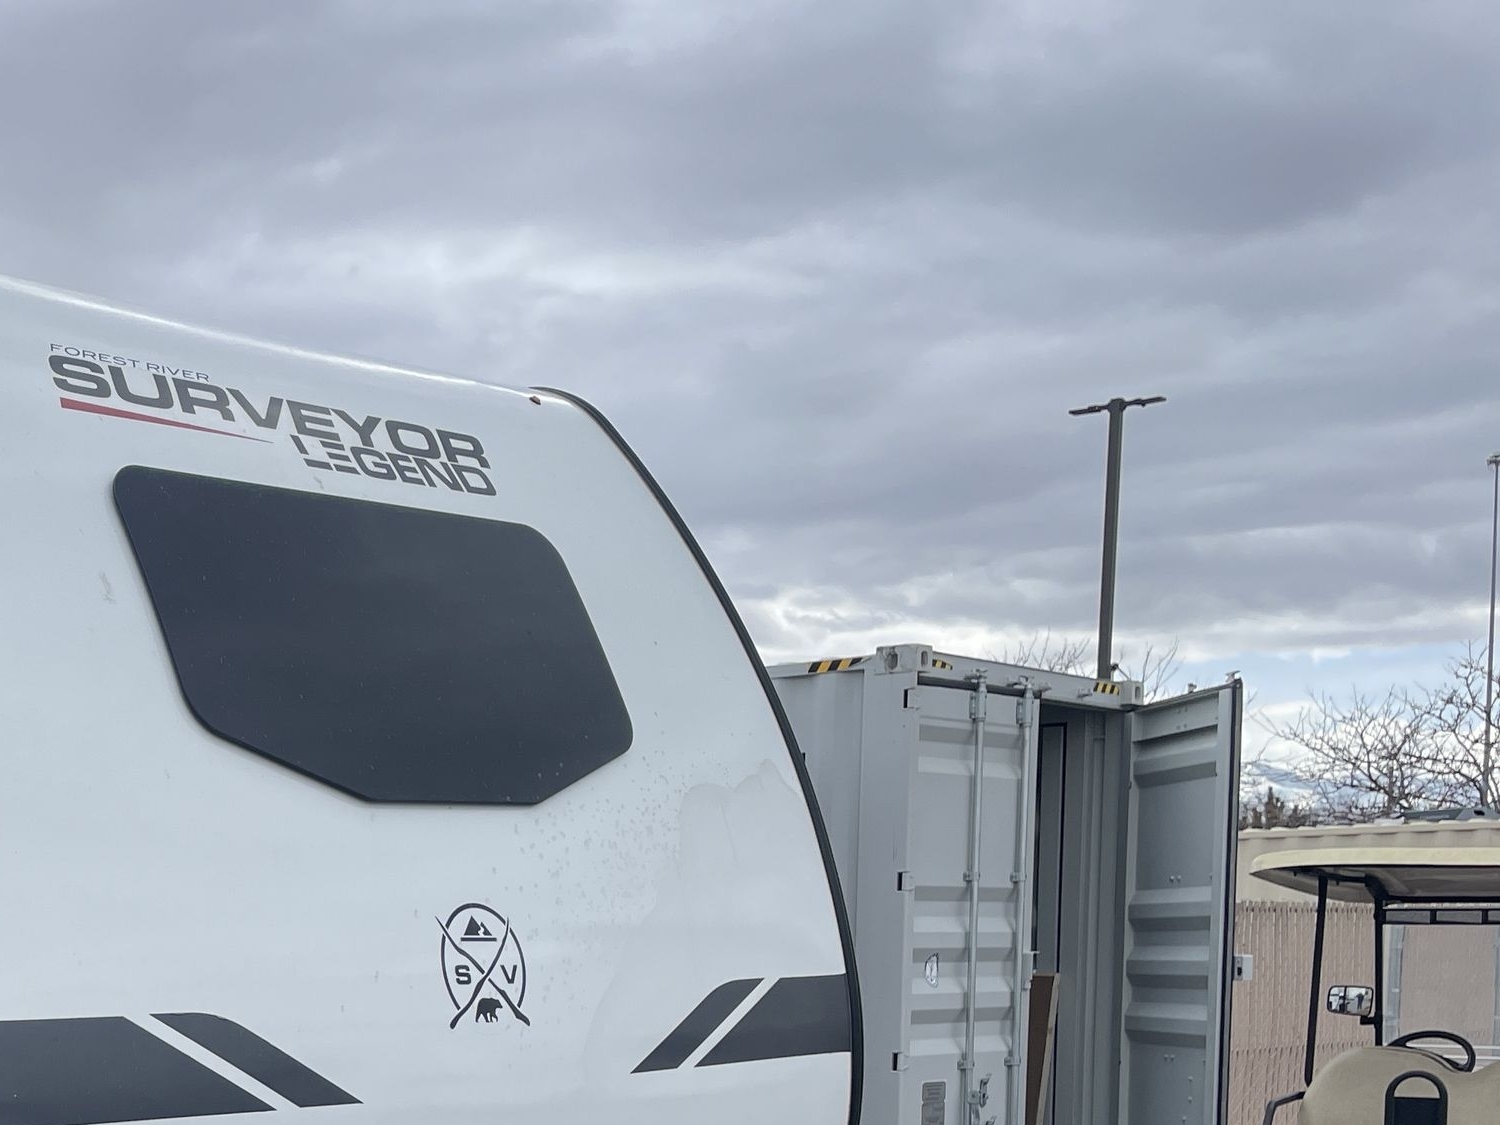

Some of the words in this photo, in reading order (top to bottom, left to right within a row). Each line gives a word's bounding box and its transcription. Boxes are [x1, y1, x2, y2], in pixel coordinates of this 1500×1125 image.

[49, 343, 140, 369] FOREST
[146, 361, 210, 383] RIVER
[48, 355, 491, 469] SURVEYOR
[289, 434, 497, 496] LEGEND
[454, 964, 472, 985] S
[499, 964, 518, 984] V
